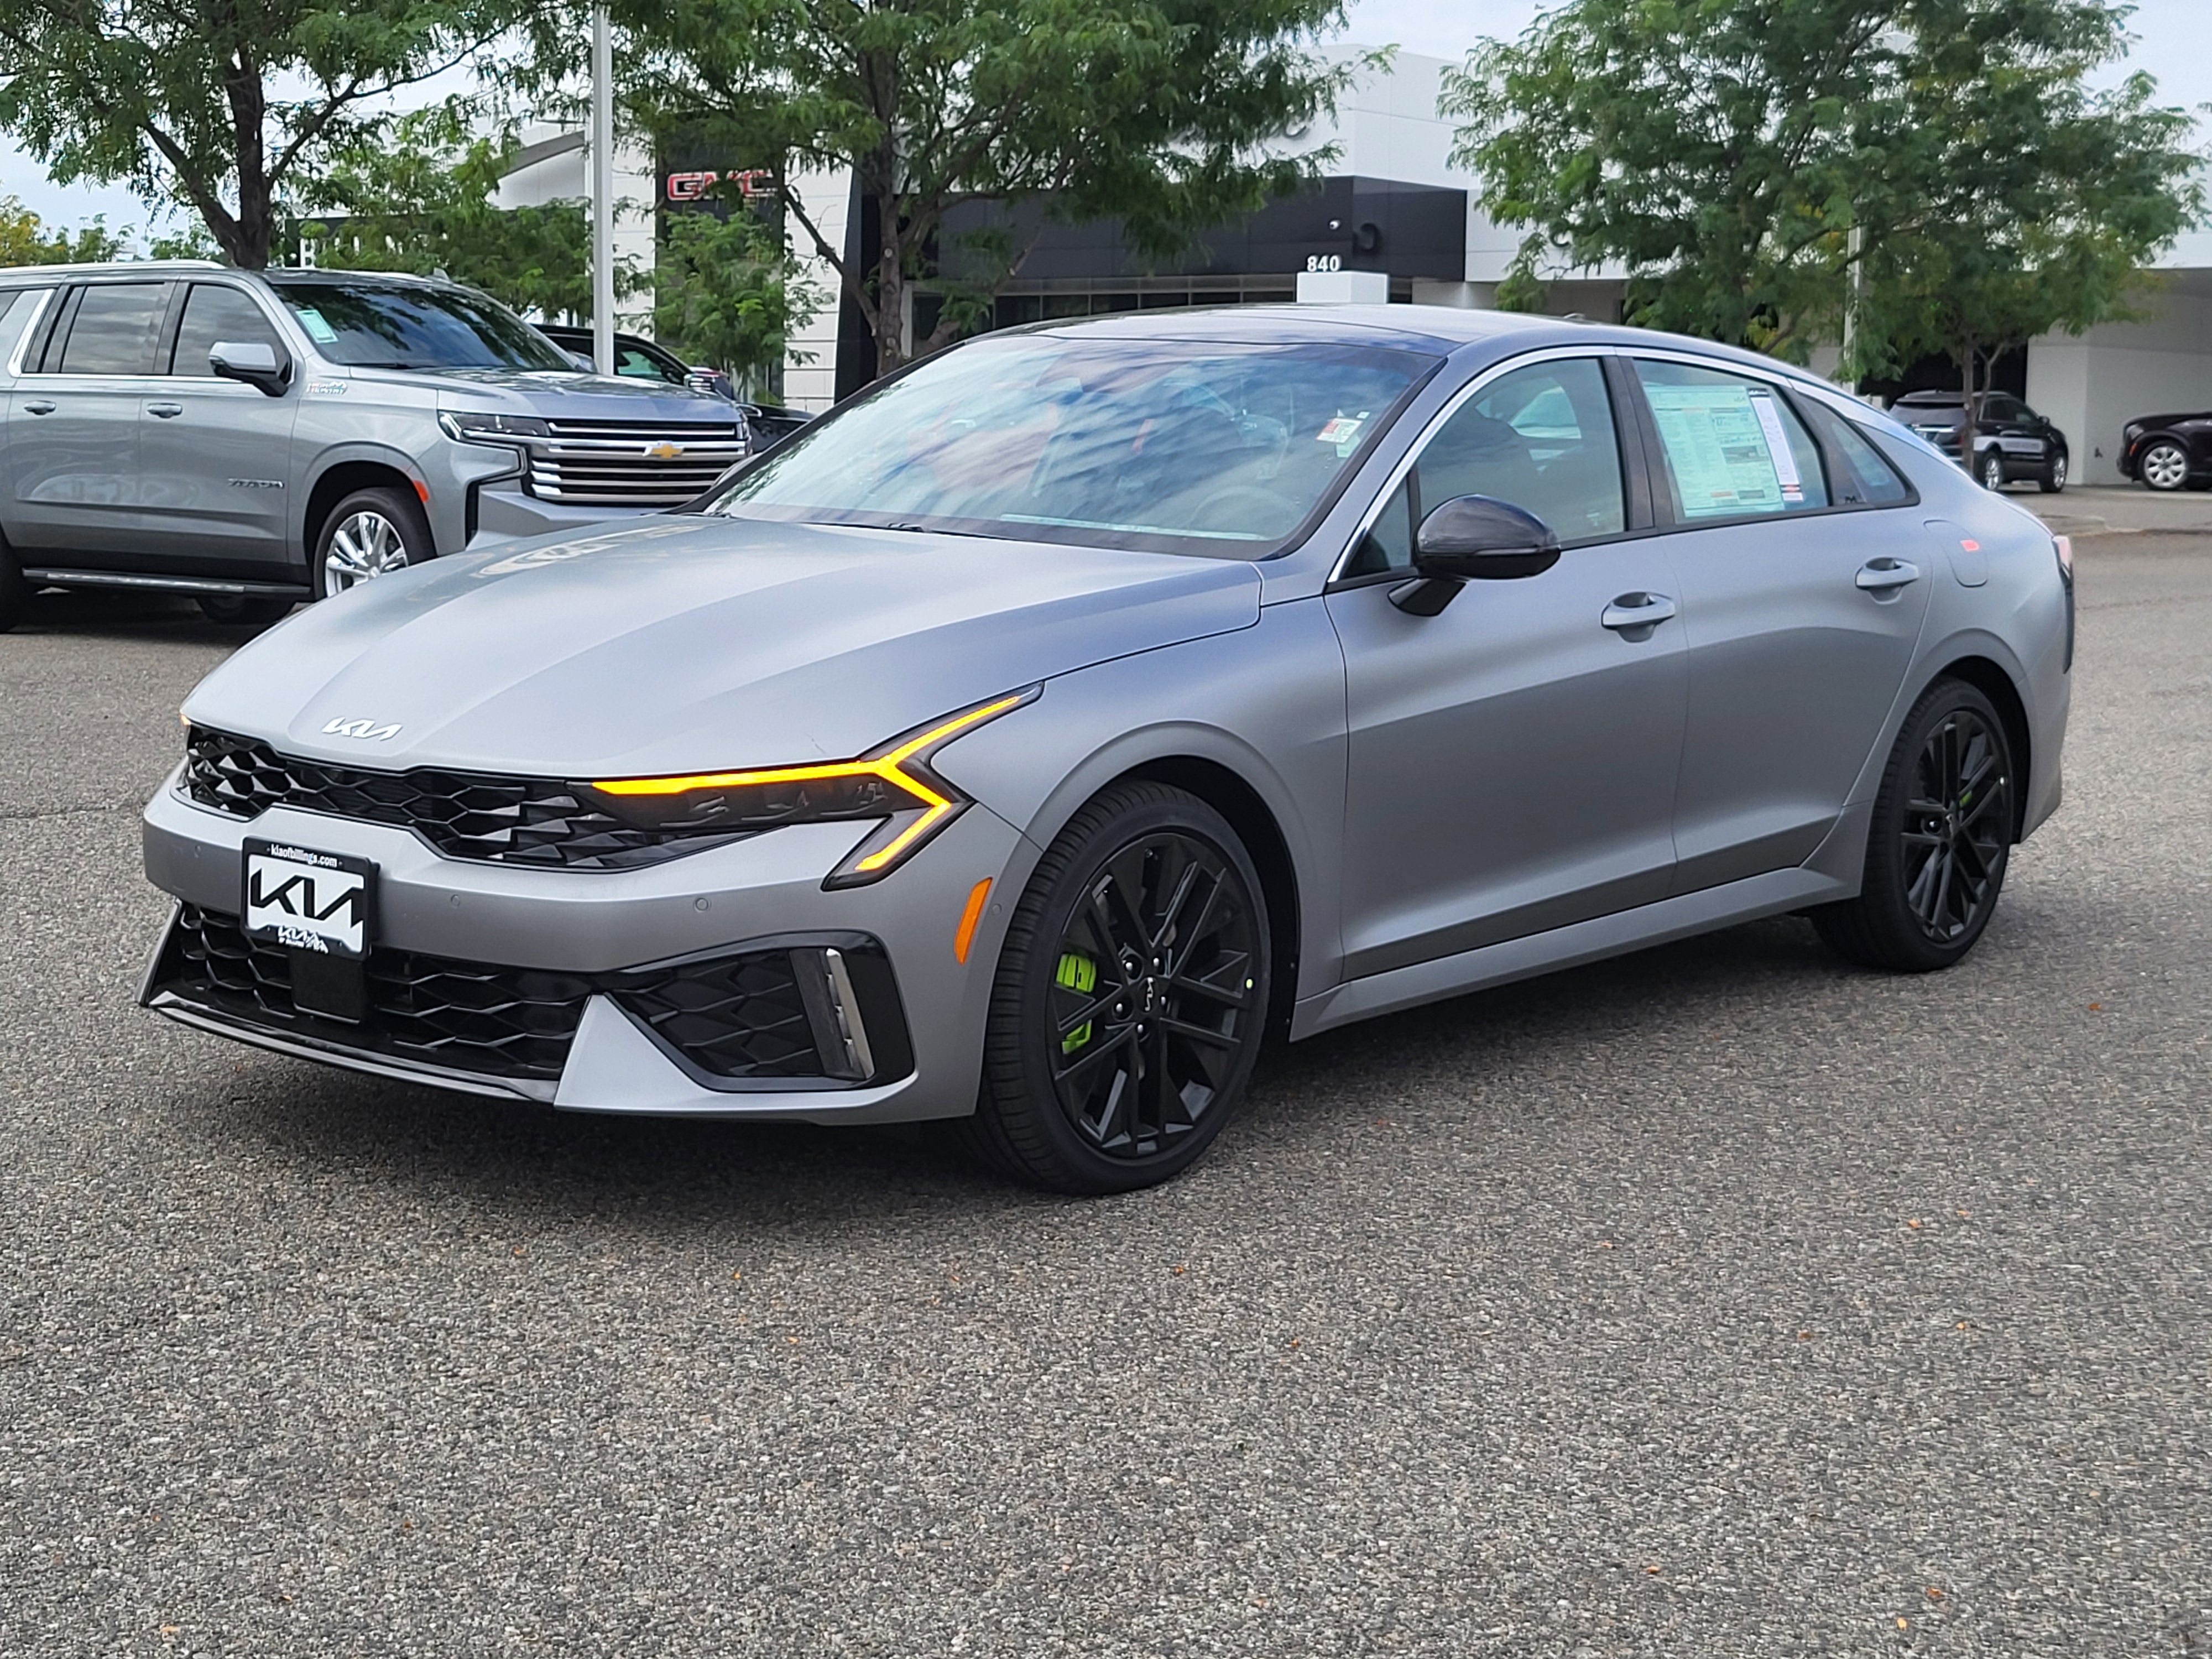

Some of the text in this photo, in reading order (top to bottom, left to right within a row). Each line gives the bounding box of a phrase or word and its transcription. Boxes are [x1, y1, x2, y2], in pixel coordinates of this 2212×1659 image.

[1307, 254, 1342, 272] 840
[322, 717, 403, 740] KIA
[250, 867, 364, 929] KIA
